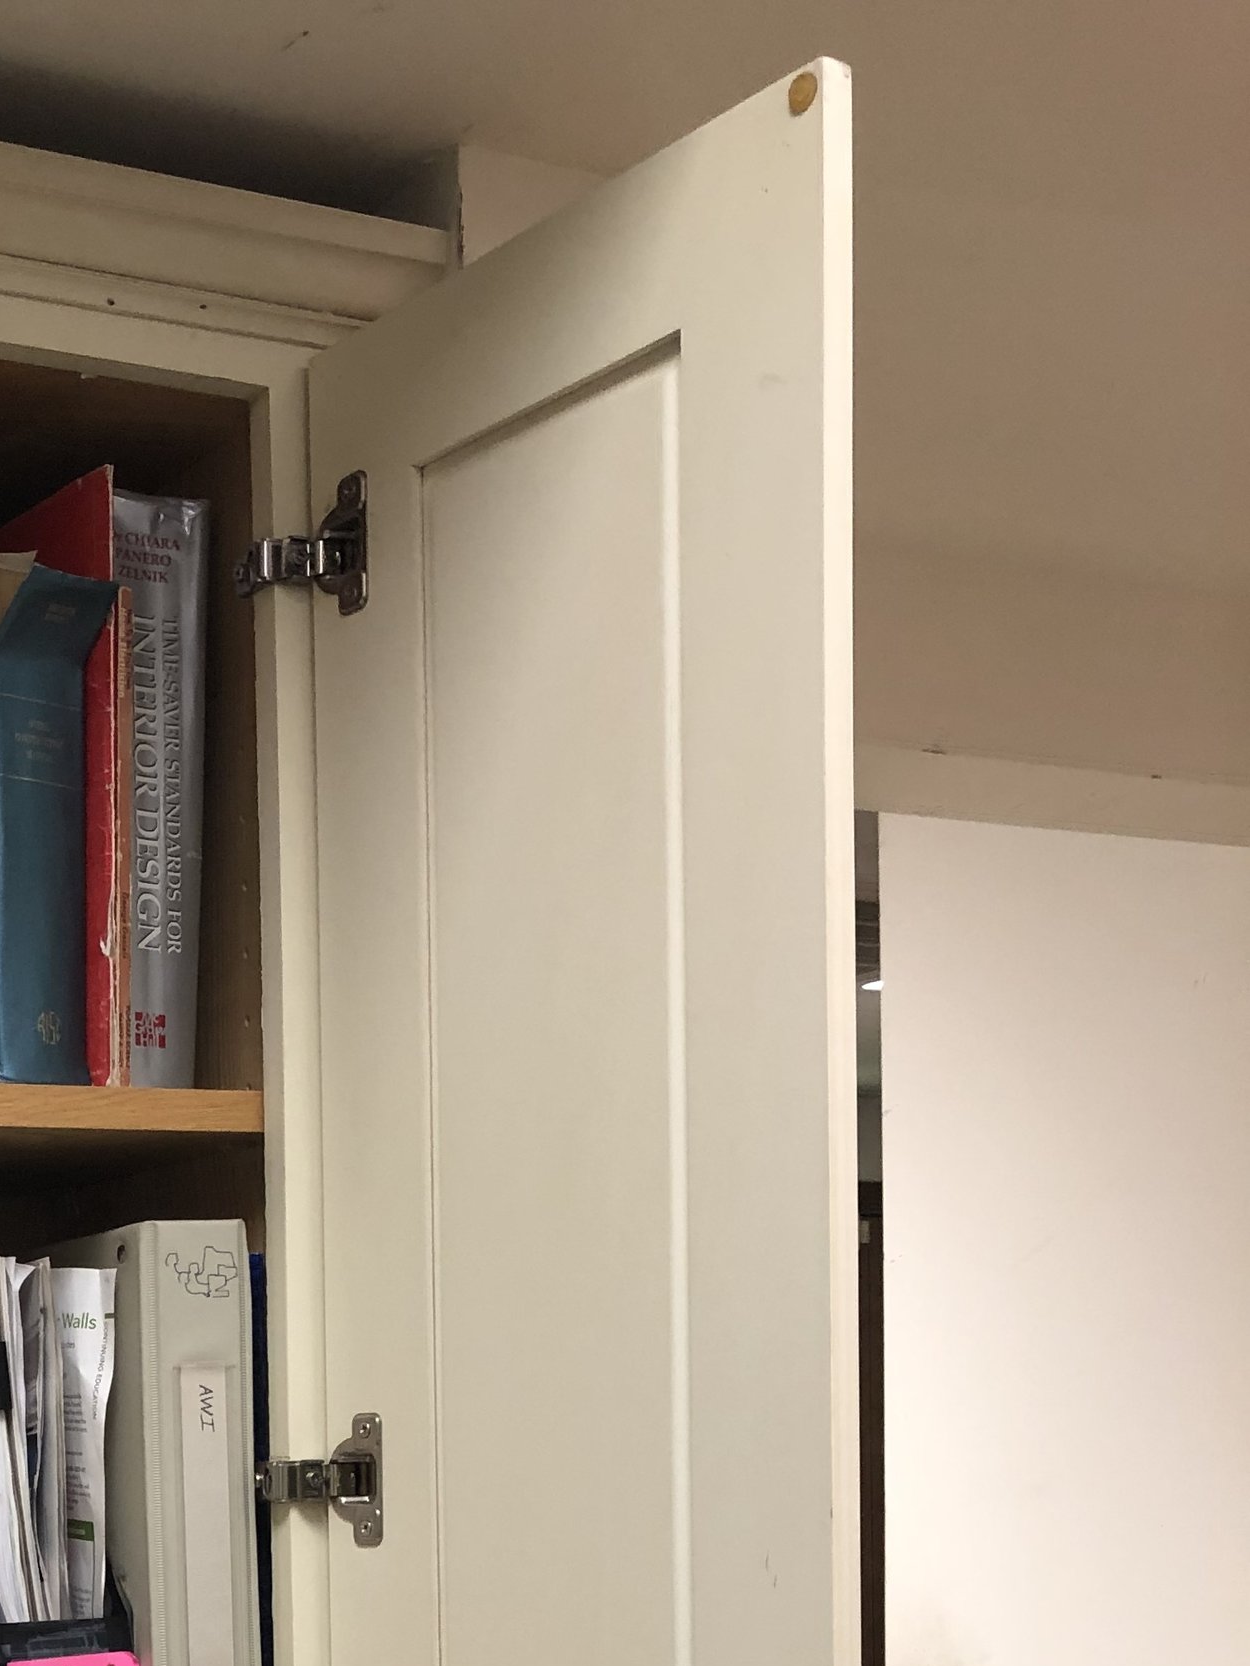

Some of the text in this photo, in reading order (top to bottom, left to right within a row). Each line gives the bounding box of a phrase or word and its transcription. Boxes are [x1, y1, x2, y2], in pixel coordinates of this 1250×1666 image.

[116, 548, 172, 567] PANERO
[125, 532, 180, 551] CHIARA
[118, 565, 168, 584] ZELNIK
[133, 614, 161, 955] INTERIOR DESIGN
[162, 616, 183, 954] TIME-SAVER STANDARDS FOR
[61, 1312, 97, 1330] Walls
[92, 1374, 103, 1420] EDUCATION
[199, 1384, 215, 1432] AWI
